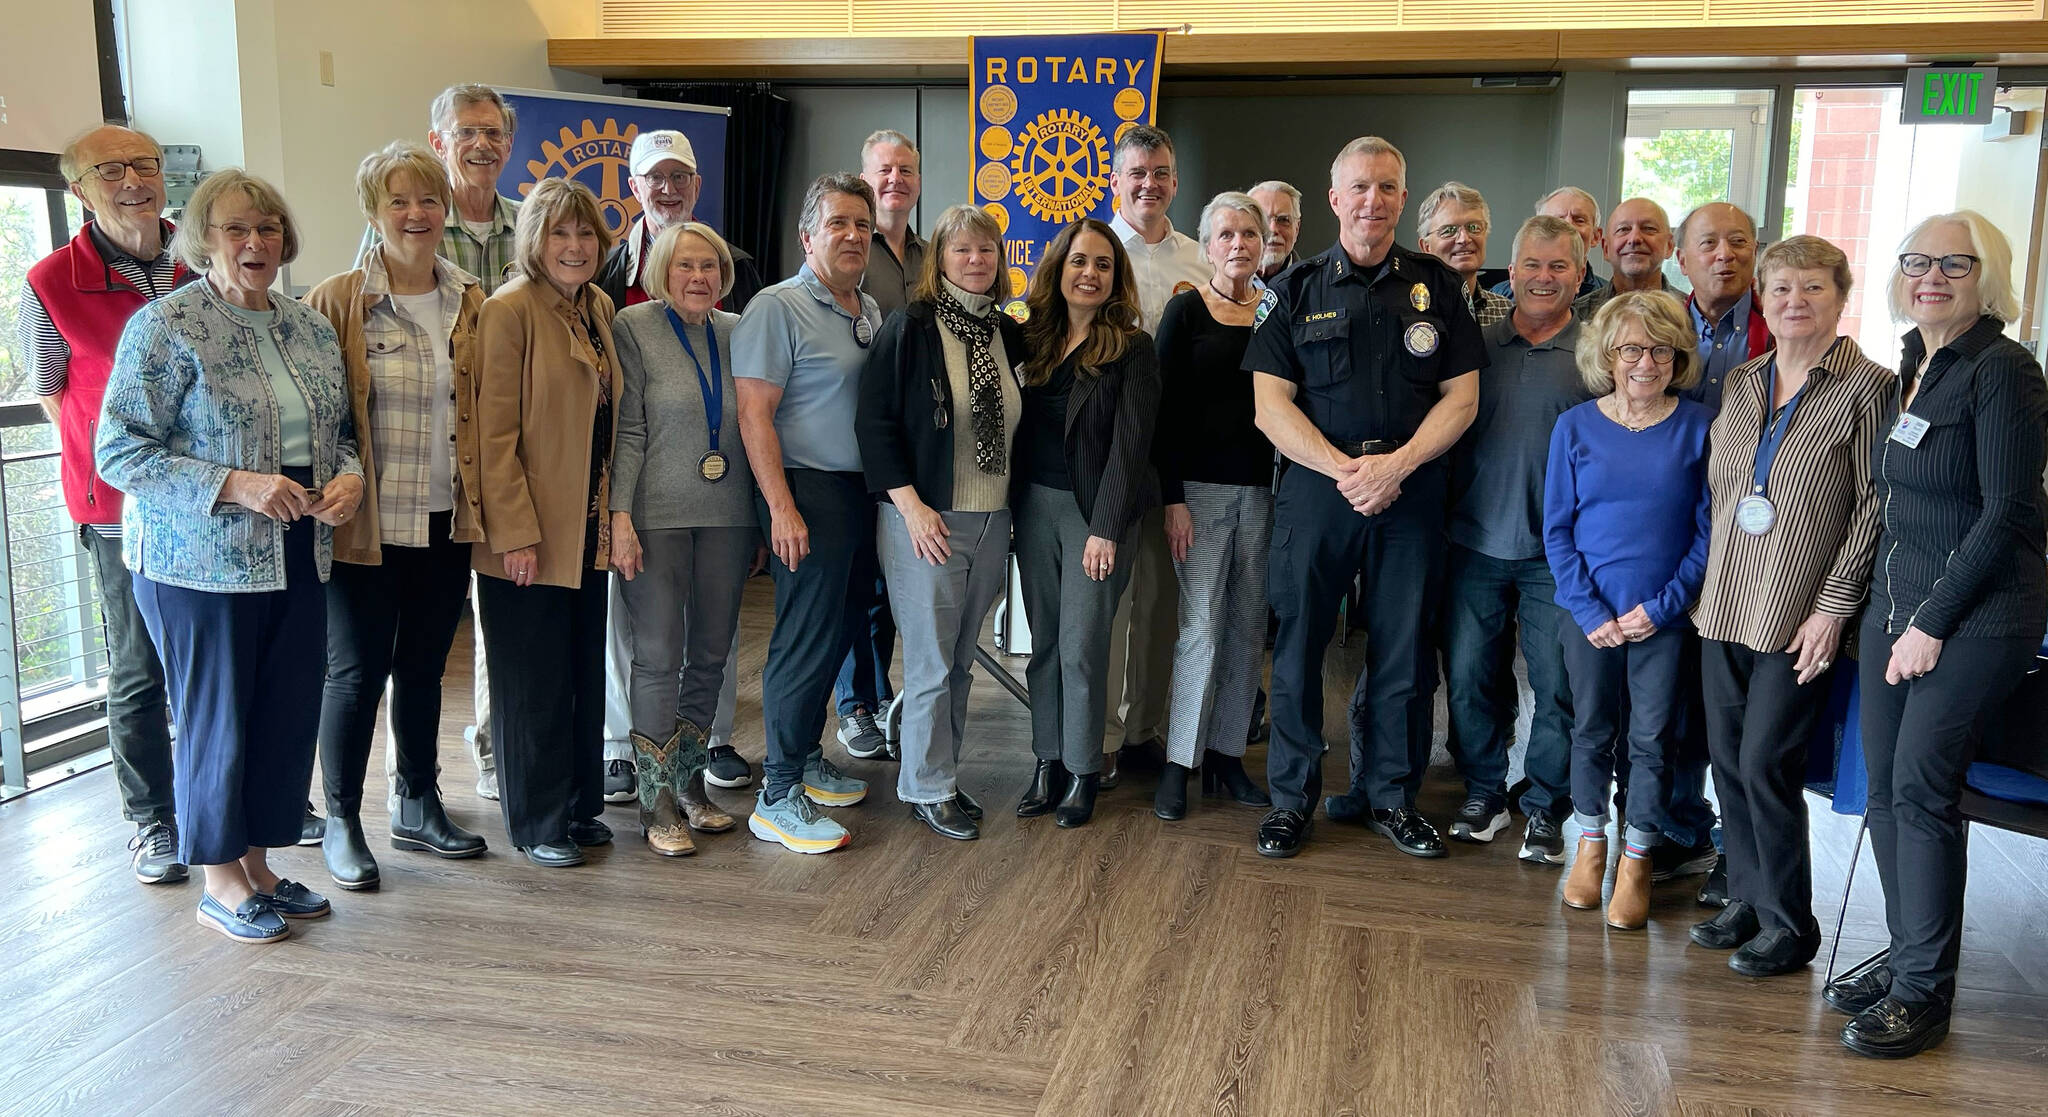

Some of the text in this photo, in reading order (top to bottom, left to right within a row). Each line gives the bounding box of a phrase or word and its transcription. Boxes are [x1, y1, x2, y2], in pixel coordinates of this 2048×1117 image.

[986, 56, 1146, 86] ROTARY
[1921, 72, 1985, 116] EXIT
[1038, 121, 1089, 140] ROTARY
[572, 140, 632, 163] ROTAR
[1023, 177, 1096, 212] INTERNATIONAL
[1005, 239, 1035, 266] VICE
[1312, 311, 1337, 321] HOLMES
[773, 813, 798, 834] HOKA
